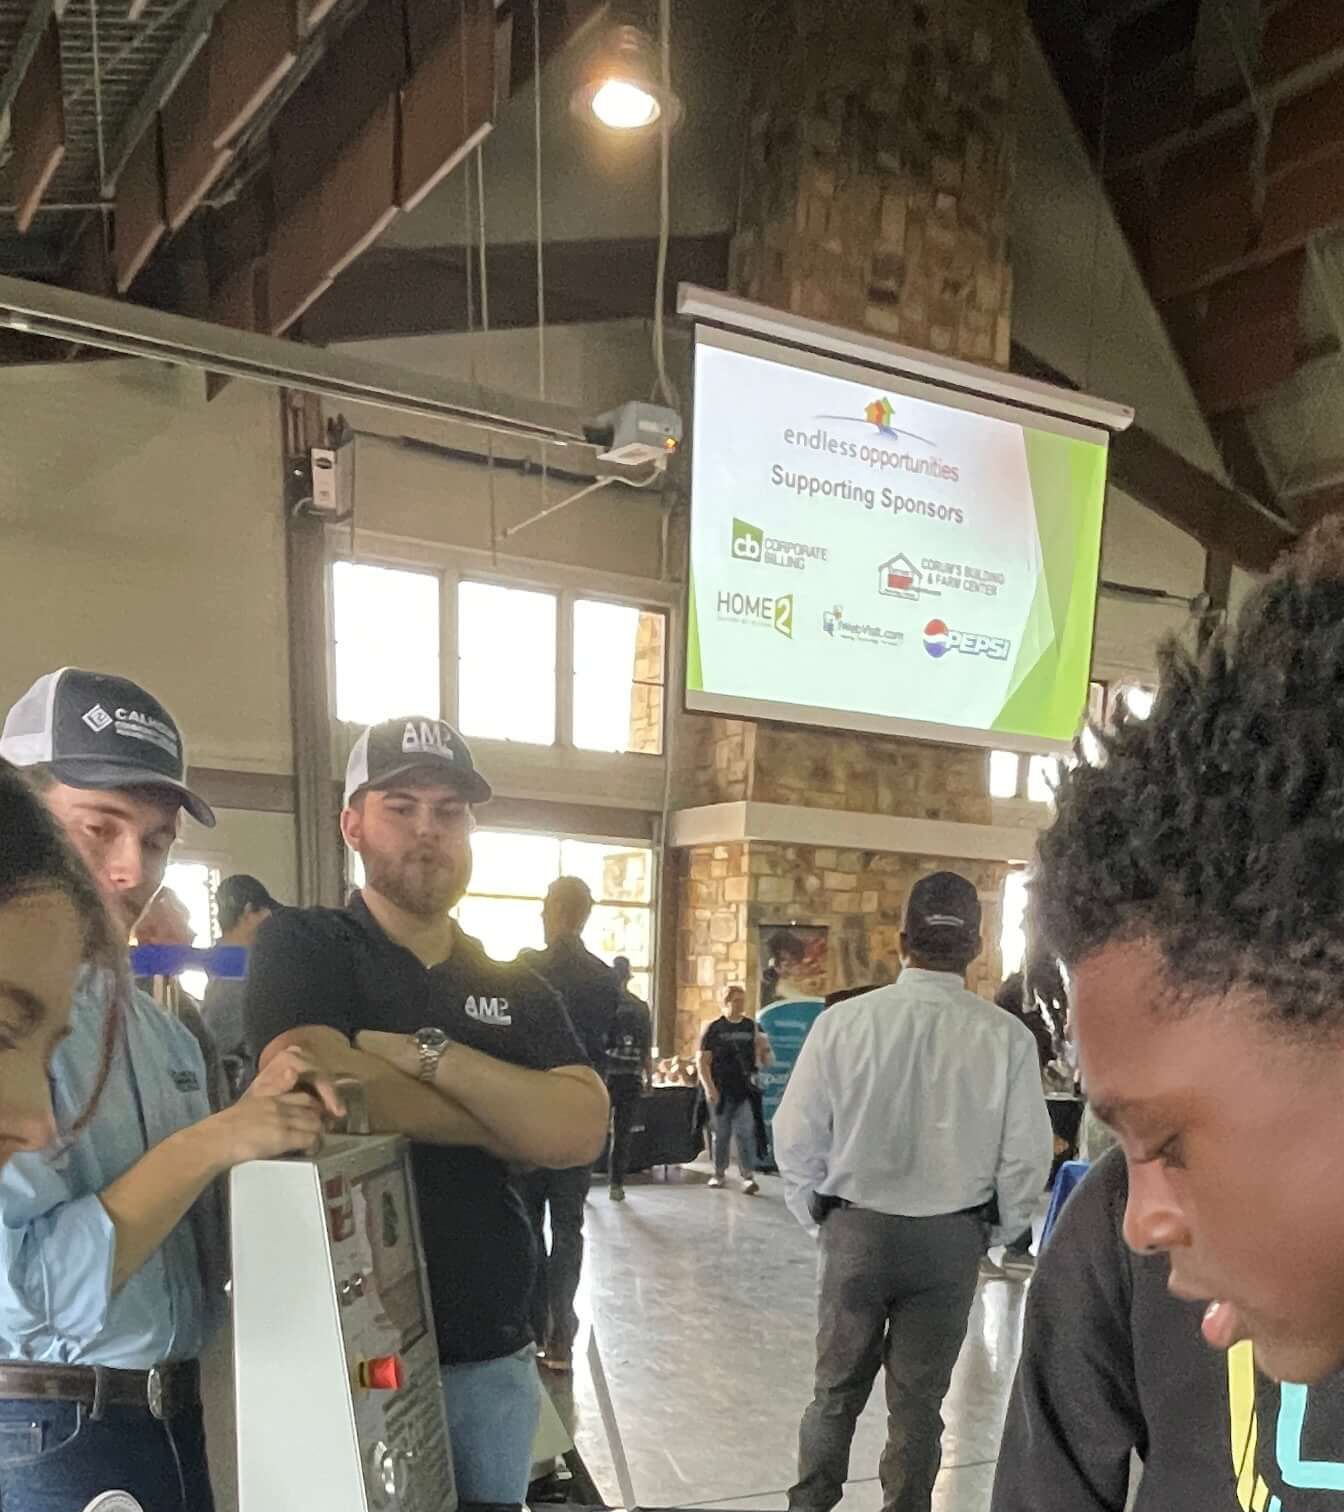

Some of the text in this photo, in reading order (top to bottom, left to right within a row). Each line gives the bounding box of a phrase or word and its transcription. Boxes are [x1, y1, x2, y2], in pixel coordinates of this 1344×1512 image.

[783, 427, 960, 482] endless opportunities
[770, 464, 964, 524] Supporting Sponsors
[764, 537, 829, 561] CORPORATE
[947, 629, 1011, 661] PEPSI
[464, 994, 509, 1019] AMP
